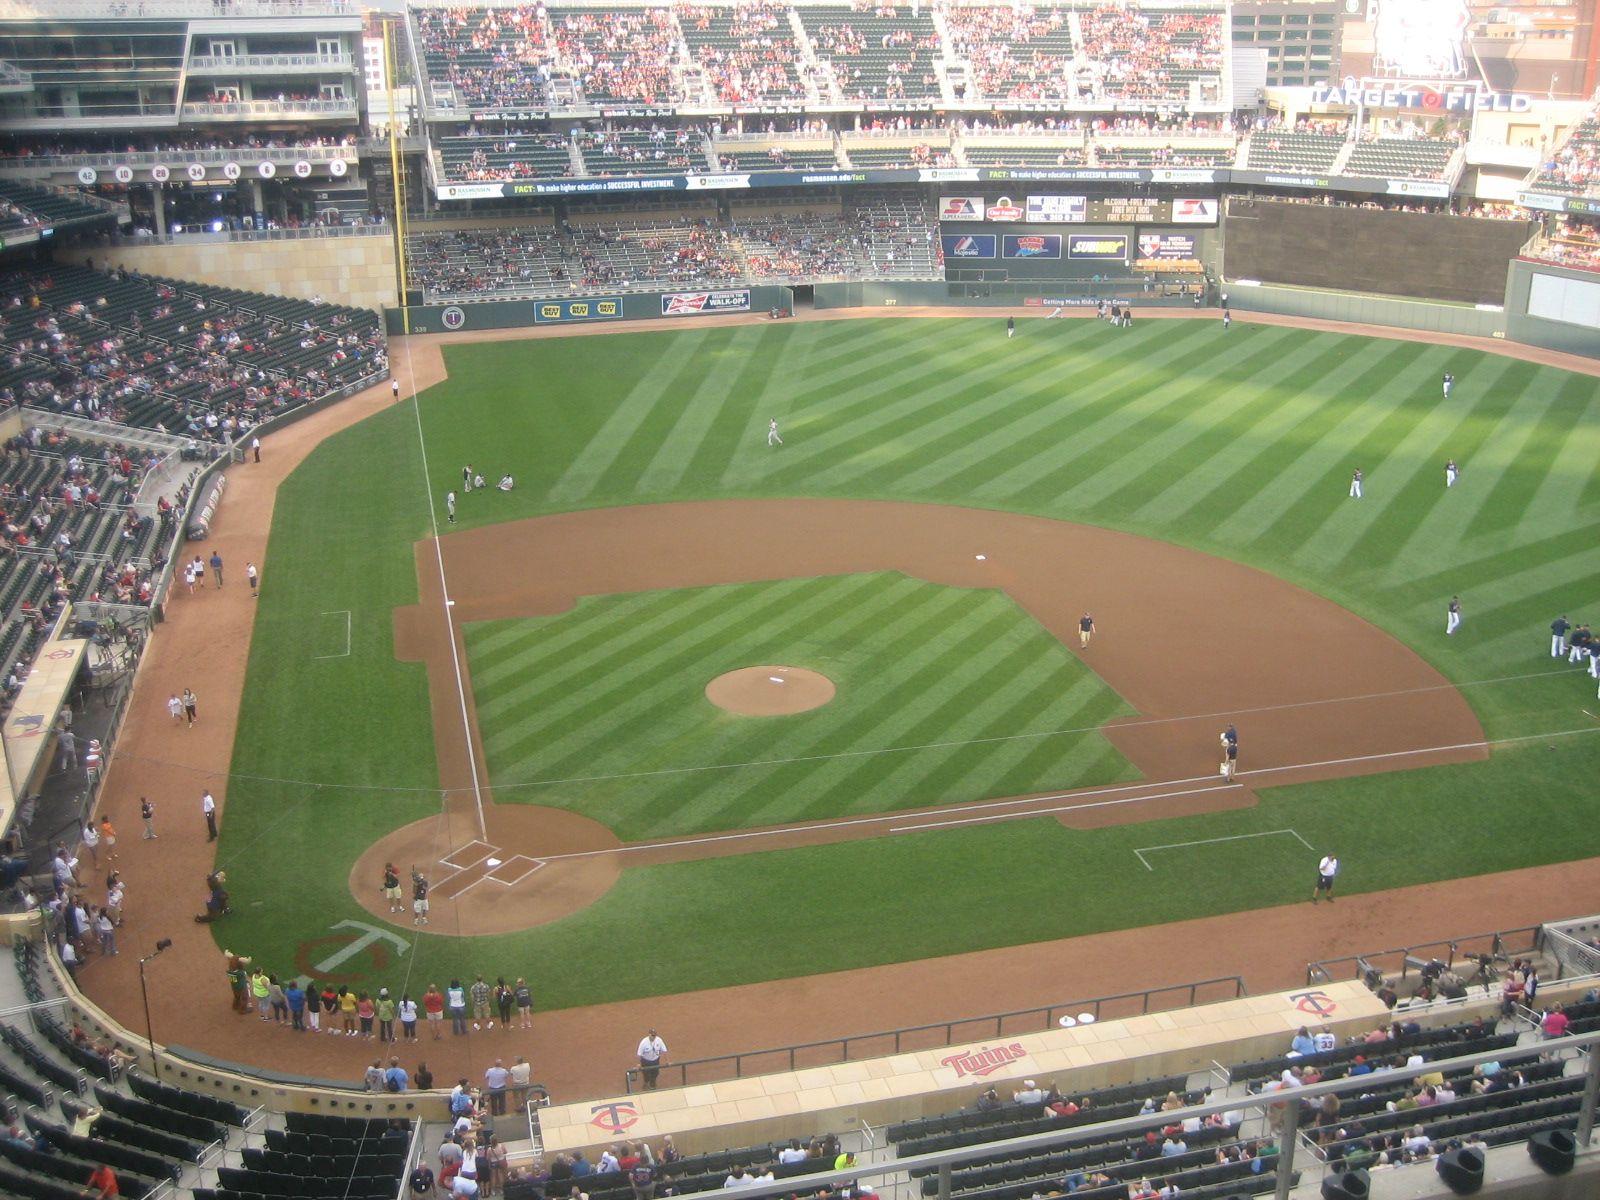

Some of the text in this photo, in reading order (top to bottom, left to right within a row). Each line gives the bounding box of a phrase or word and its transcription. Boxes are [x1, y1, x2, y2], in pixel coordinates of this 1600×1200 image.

[1312, 88, 1532, 112] TARGET FIELD
[514, 185, 536, 193] FACT:
[577, 182, 603, 191] education
[607, 181, 641, 189] SUCCESSFUL
[1567, 200, 1588, 210] FACT:
[1072, 240, 1124, 253] SUBWAY
[709, 297, 746, 306] WALK-OFF
[1320, 1040, 1333, 1049] 33
[941, 1042, 1027, 1078] Twins
